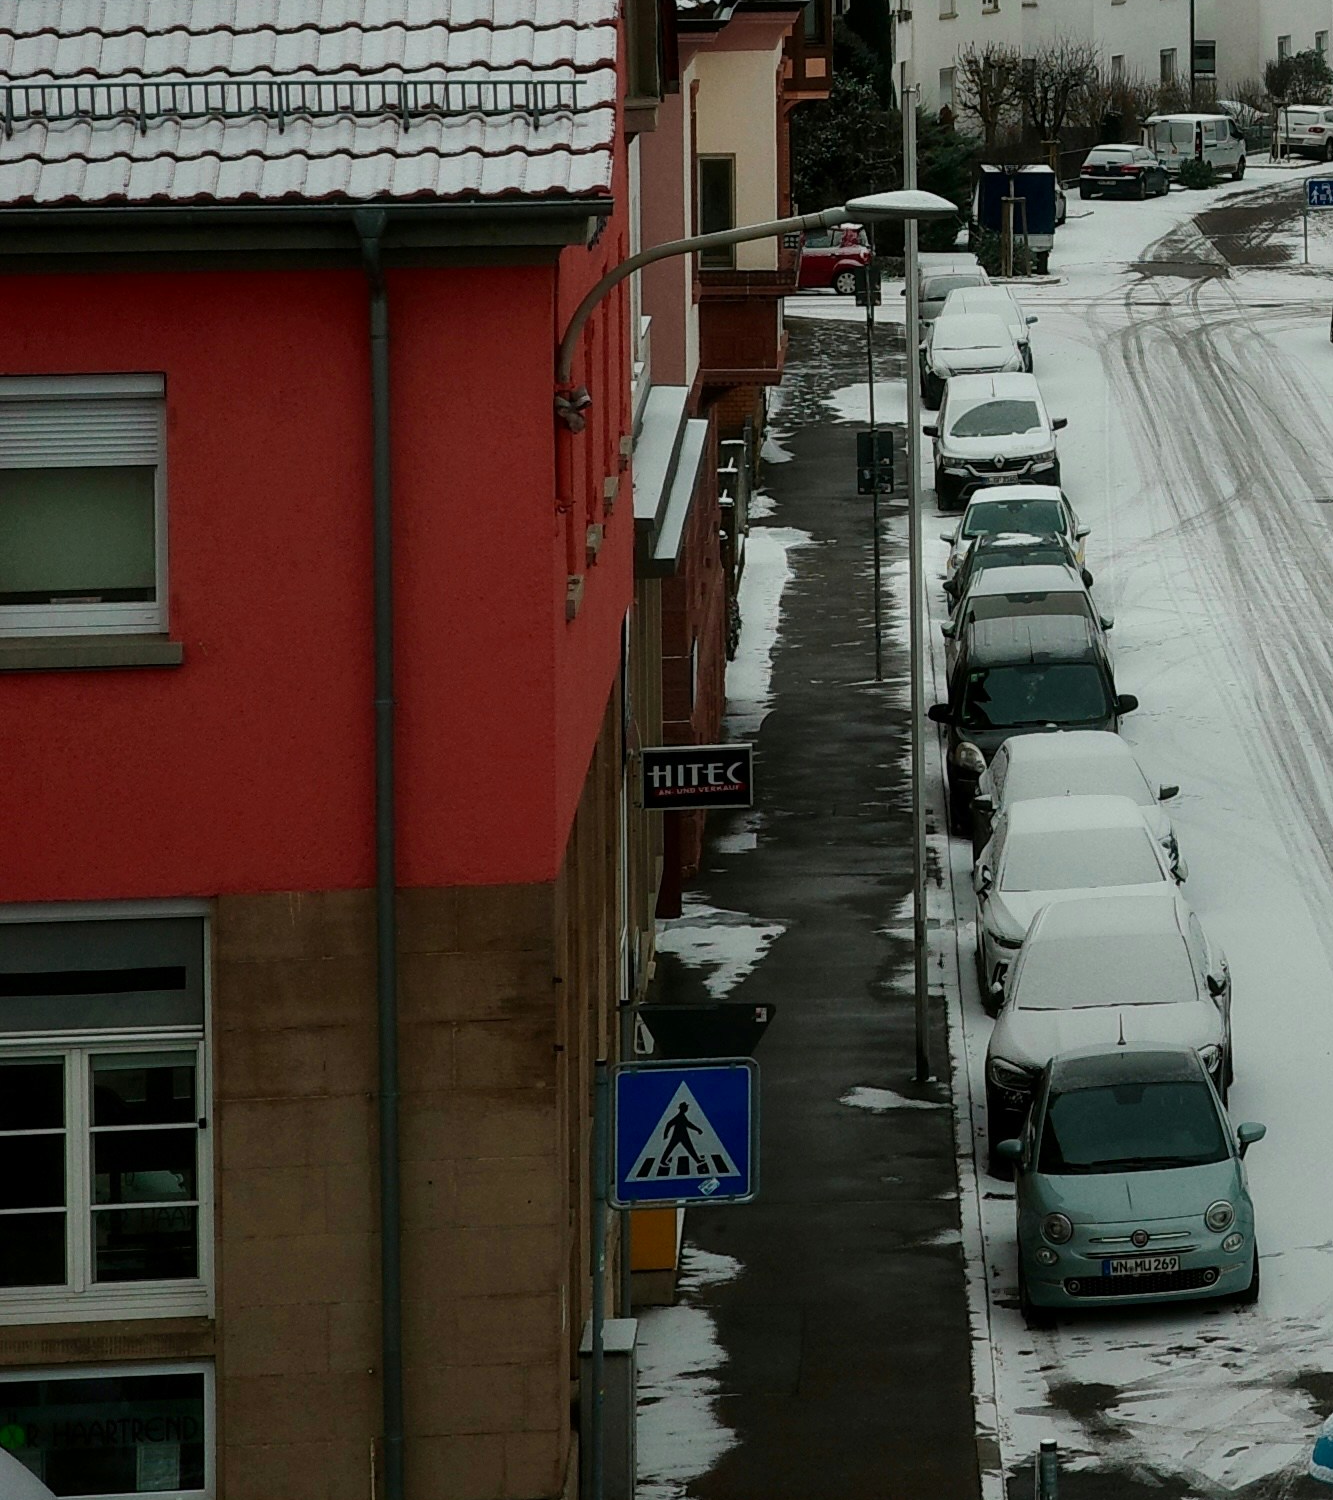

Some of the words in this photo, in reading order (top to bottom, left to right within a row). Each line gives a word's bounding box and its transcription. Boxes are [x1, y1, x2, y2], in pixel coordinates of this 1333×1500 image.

[647, 761, 744, 788] HITEC
[676, 787, 696, 795] UND
[698, 784, 740, 793] VERKAUF
[1111, 1259, 1128, 1273] WN
[1134, 1259, 1152, 1273] MU
[1153, 1257, 1177, 1271] 269
[52, 1415, 199, 1448] HAARTREND
